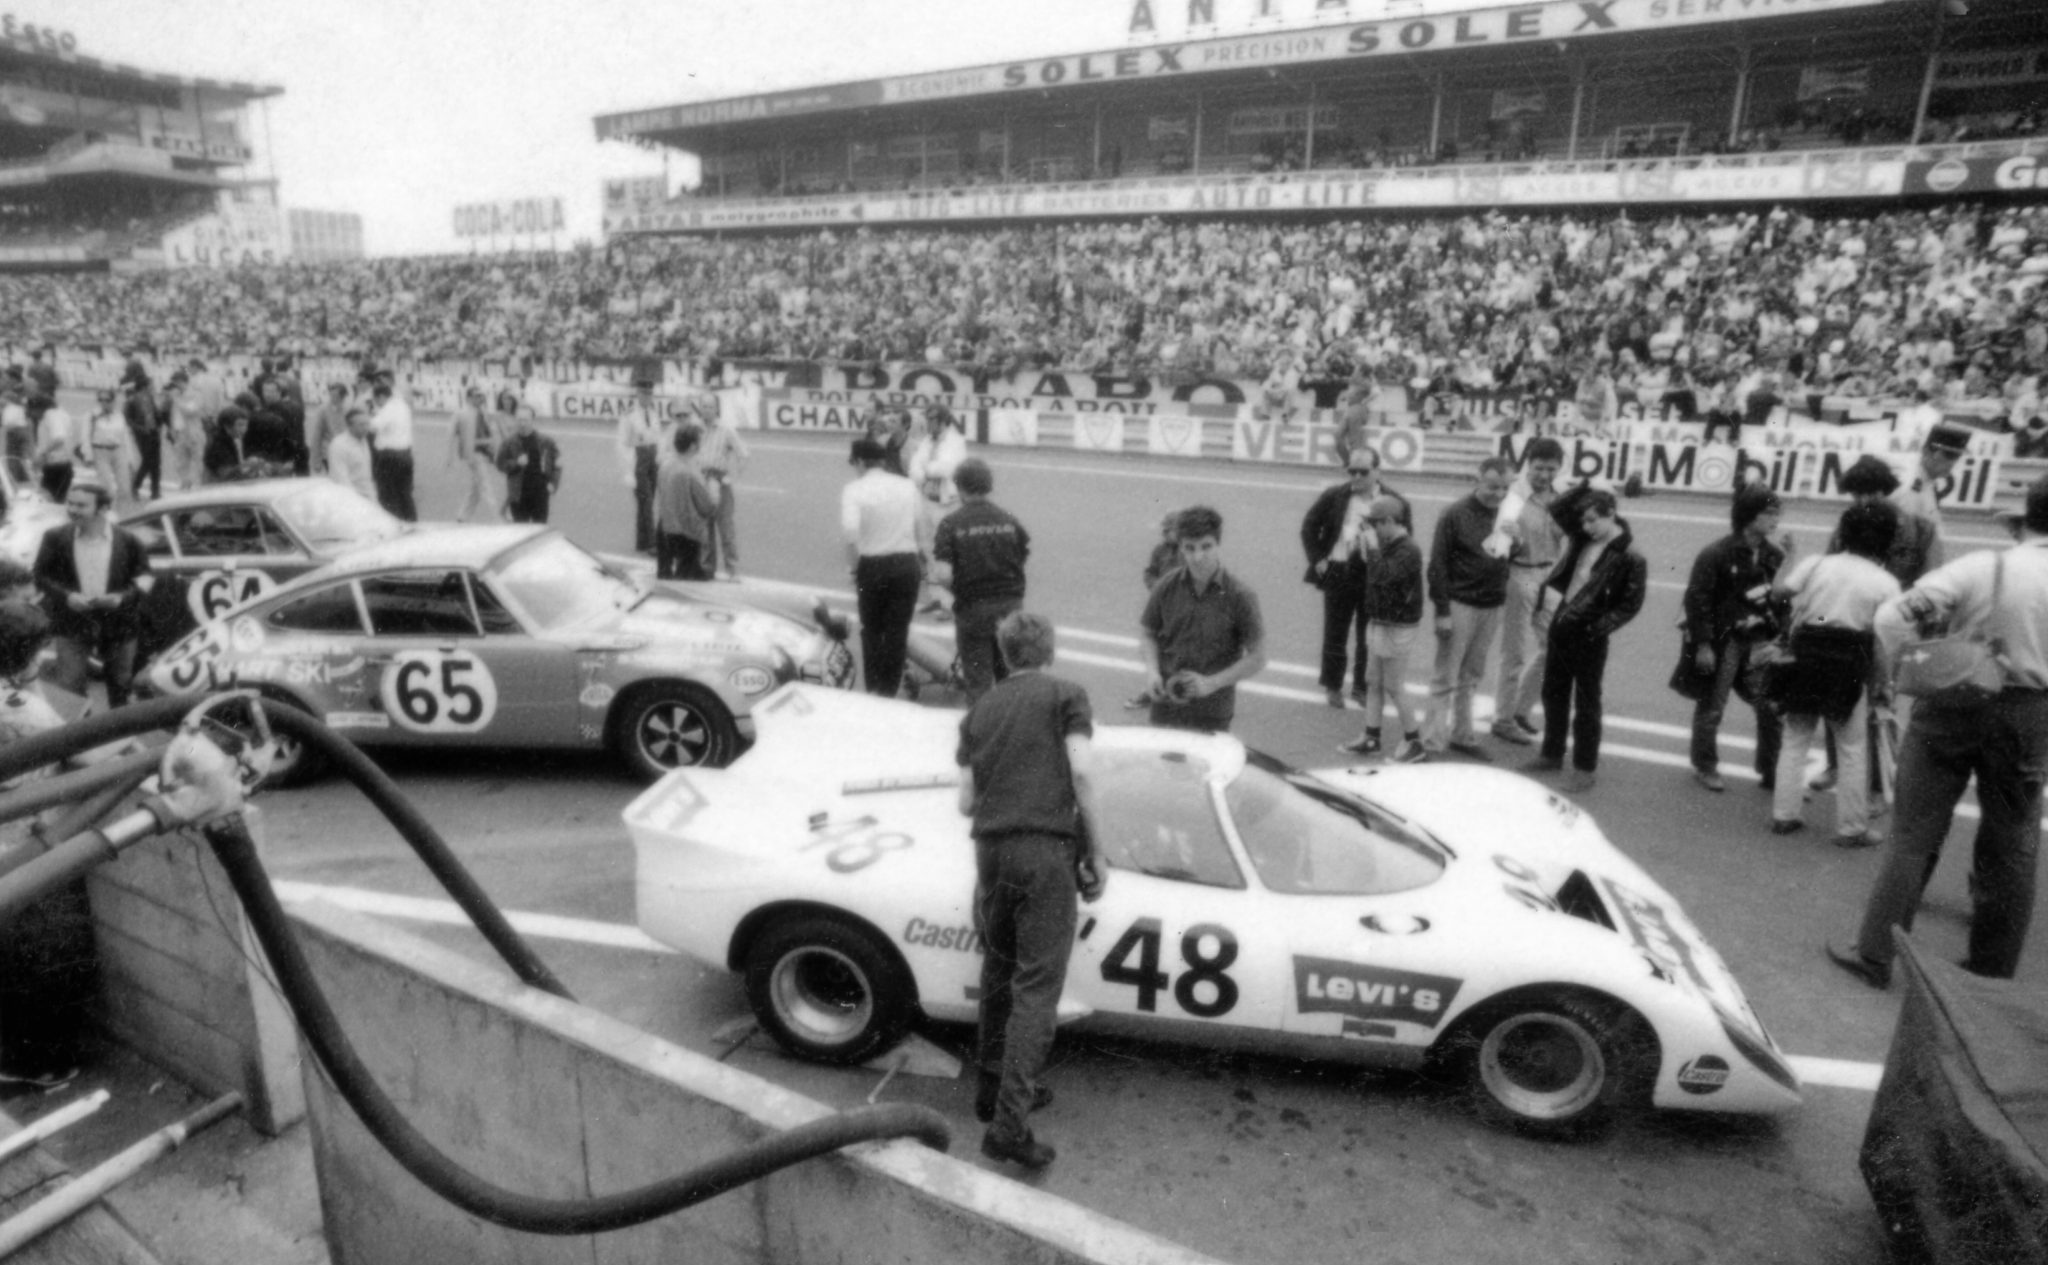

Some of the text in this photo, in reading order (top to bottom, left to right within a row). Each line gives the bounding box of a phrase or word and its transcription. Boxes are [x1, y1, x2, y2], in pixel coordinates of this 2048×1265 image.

[1003, 47, 1183, 89] SOLEX
[1345, 0, 1618, 54] SOLEX
[711, 204, 840, 224] molygraphite
[1191, 182, 1377, 208] AUTO-LITE
[453, 197, 566, 237] COCA-COLA
[174, 245, 274, 267] LUCAS
[774, 404, 968, 437] CHAMN
[1240, 421, 1418, 467] VERO
[1500, 435, 1628, 481] Mbil
[1648, 444, 1798, 493] Mobil
[288, 662, 331, 685] SKI
[396, 660, 484, 725] 65
[903, 917, 984, 955] Castr
[1101, 917, 1239, 1018] 48
[1306, 972, 1442, 1012] Levi's
